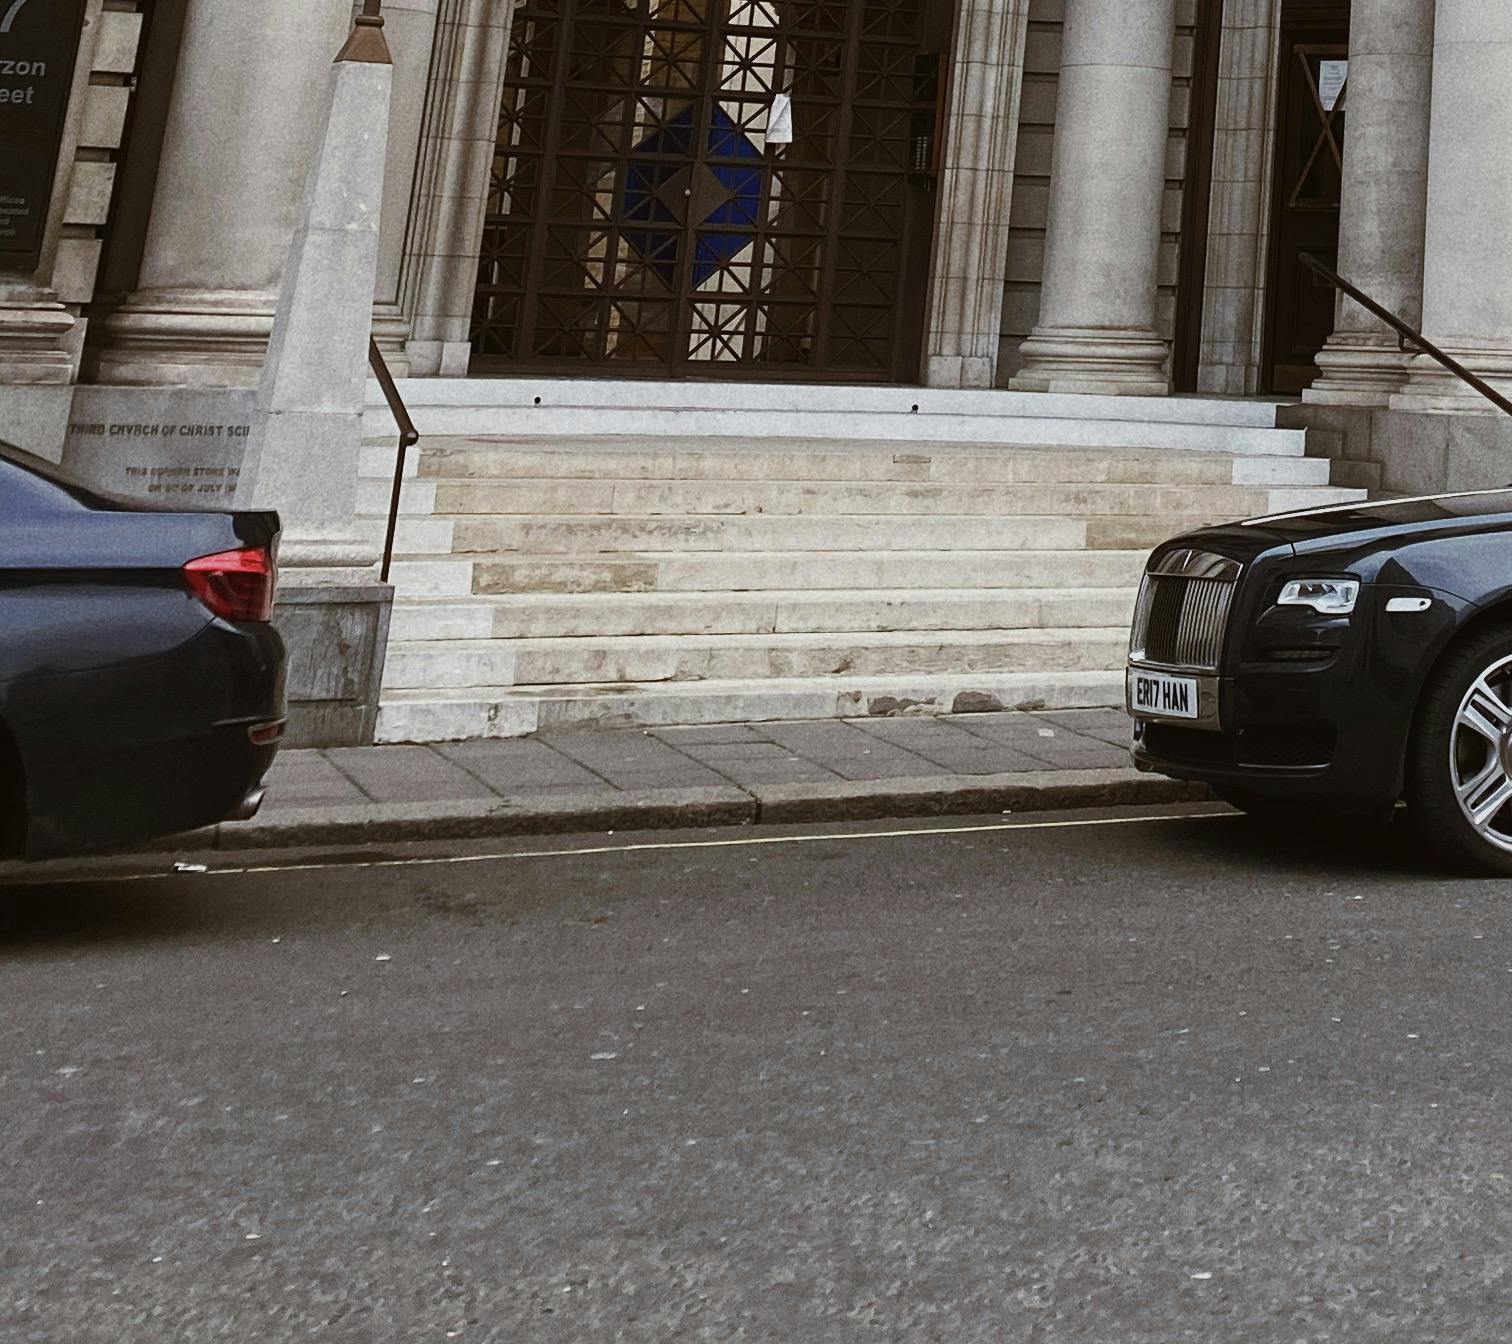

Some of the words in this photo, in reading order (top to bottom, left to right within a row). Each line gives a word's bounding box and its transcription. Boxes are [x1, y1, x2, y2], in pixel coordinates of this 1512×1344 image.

[0, 60, 46, 77] zon
[69, 423, 105, 436] THIRD
[179, 425, 224, 437] CHRIST
[1162, 680, 1189, 713] HAN
